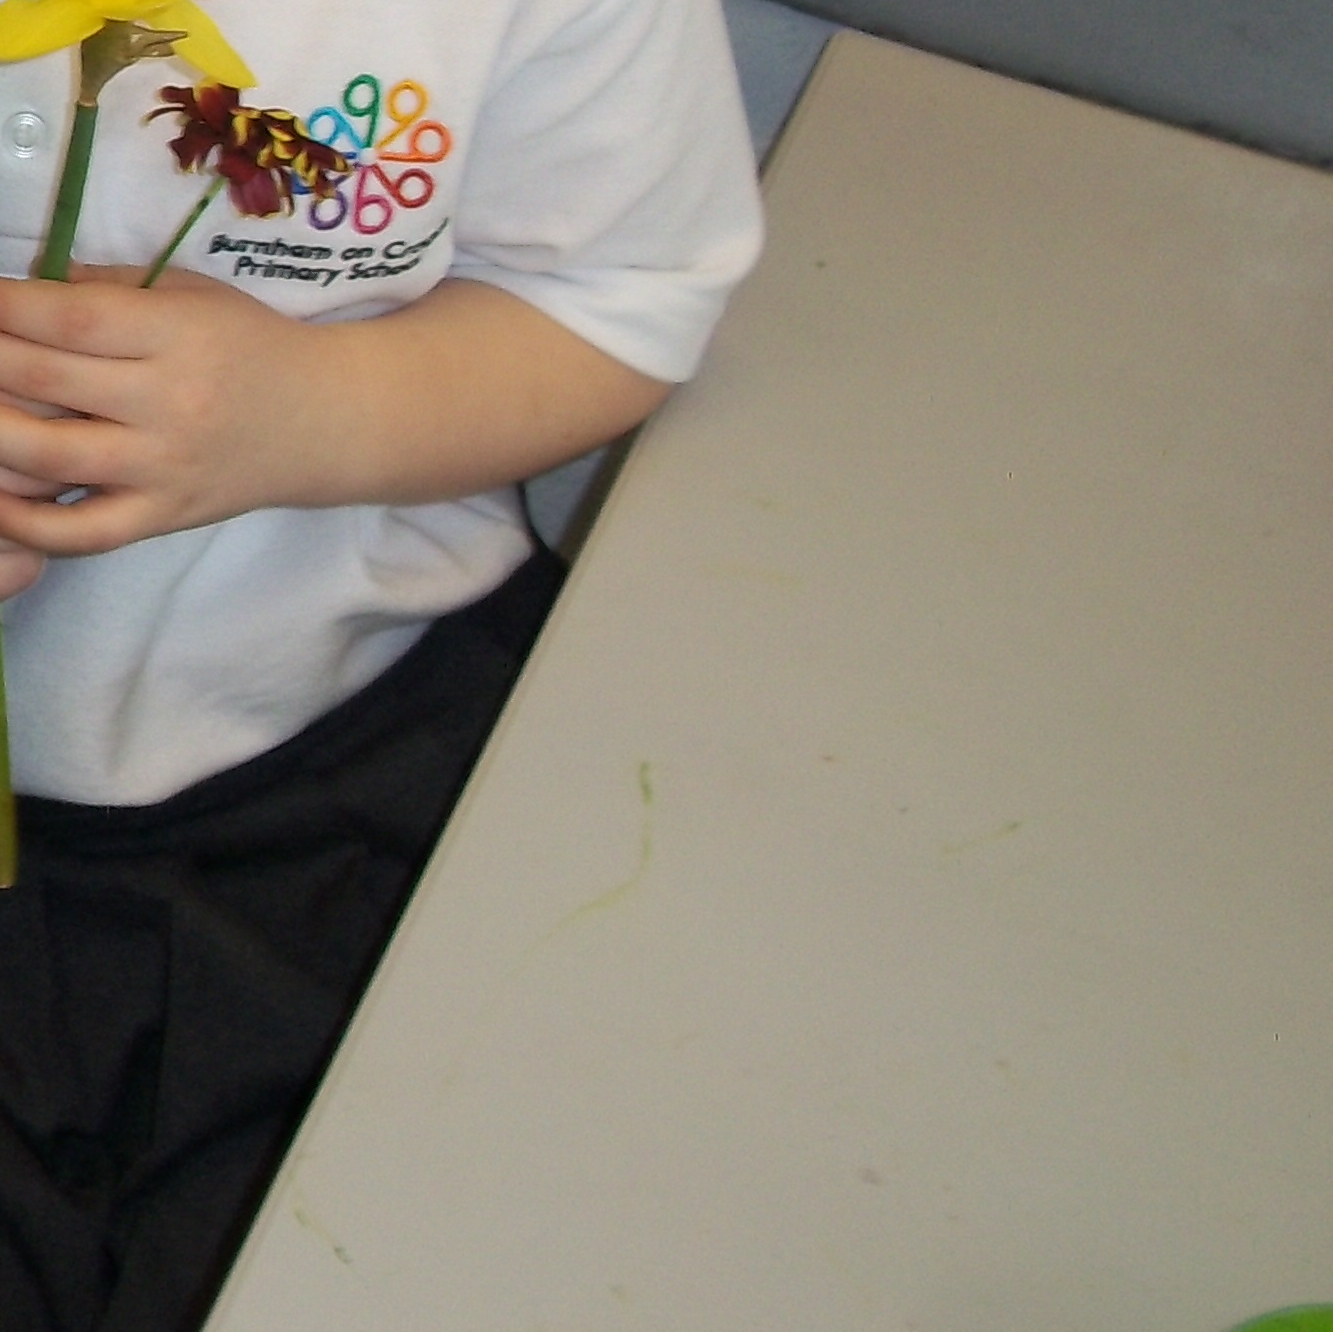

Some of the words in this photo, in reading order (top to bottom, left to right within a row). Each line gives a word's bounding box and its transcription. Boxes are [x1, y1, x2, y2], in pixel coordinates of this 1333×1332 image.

[208, 233, 332, 260] Burnham
[341, 247, 374, 261] on
[233, 255, 342, 288] Primary
